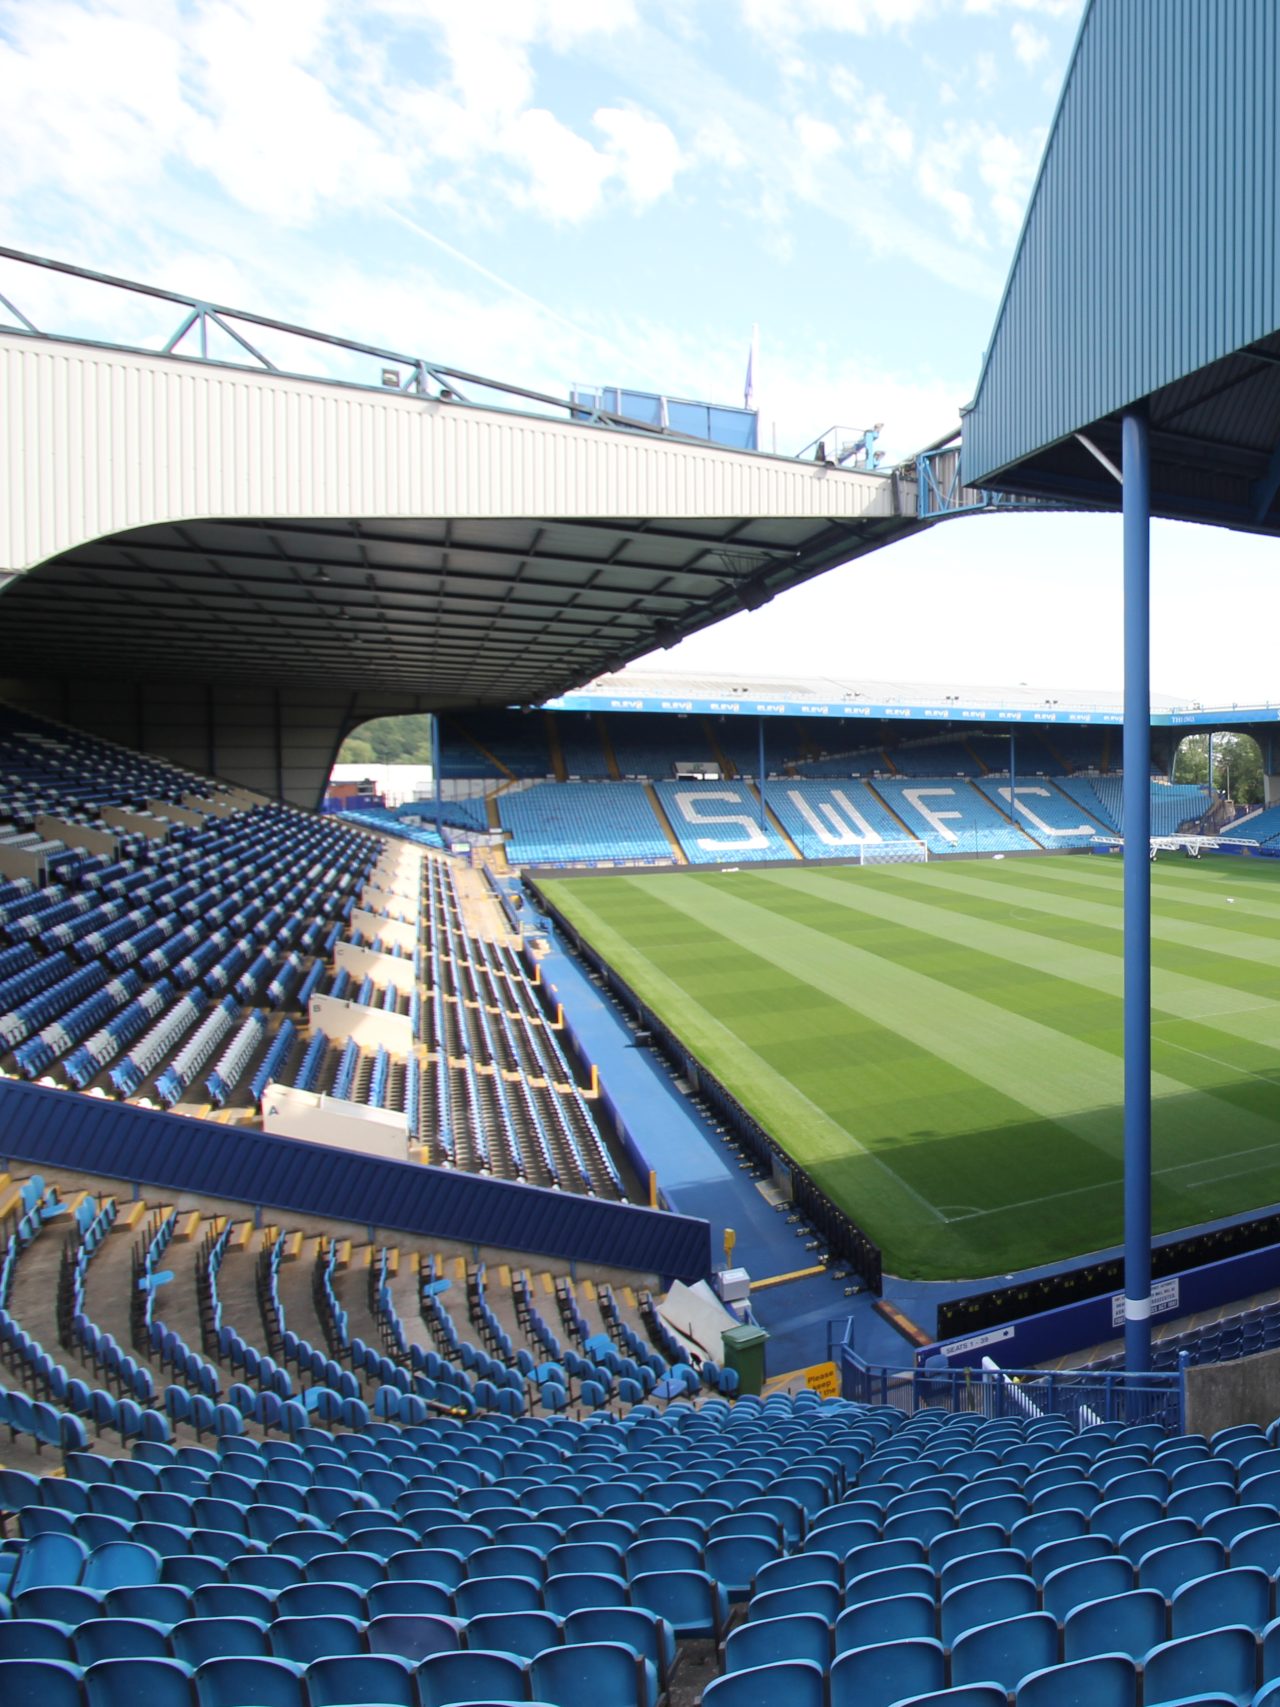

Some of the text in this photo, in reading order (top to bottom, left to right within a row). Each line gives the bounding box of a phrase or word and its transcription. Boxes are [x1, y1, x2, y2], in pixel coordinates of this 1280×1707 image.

[674, 788, 1096, 850] SWFC
[269, 1105, 278, 1115] A
[946, 1343, 968, 1354] SEATS
[807, 1370, 834, 1384] Please
